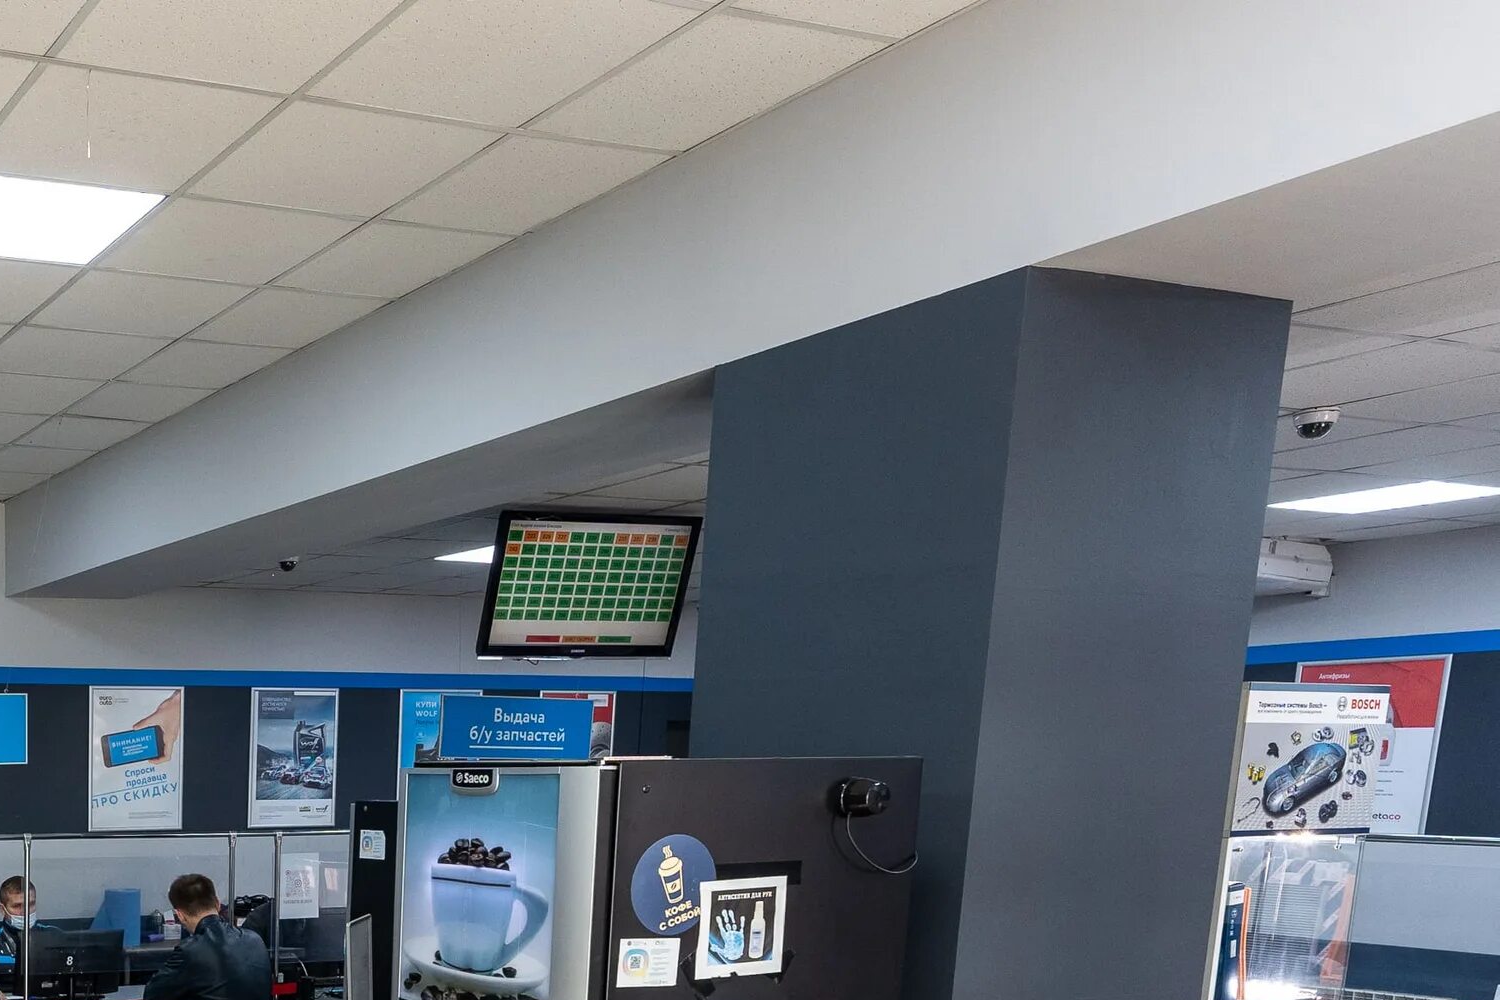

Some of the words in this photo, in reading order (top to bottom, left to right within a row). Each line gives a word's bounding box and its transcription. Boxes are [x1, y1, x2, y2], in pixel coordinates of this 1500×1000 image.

[1318, 673, 1351, 682] Антифризы
[1258, 701, 1286, 709] Тормозные
[1351, 699, 1381, 710] BOSCH
[494, 707, 545, 724] Выдача
[111, 735, 152, 748] ВНИМАНИЕ!
[469, 726, 493, 744] б/у
[496, 728, 565, 742] запчастей
[125, 766, 155, 778] Спроси
[463, 772, 489, 784] Saeco
[126, 773, 167, 787] продавца
[91, 795, 118, 809] ПРО
[124, 783, 178, 802] СКИДКУ
[665, 900, 692, 918] КОФЕ
[659, 922, 667, 930] С
[668, 906, 700, 927] СОБОЙ
[66, 956, 74, 966] 8
